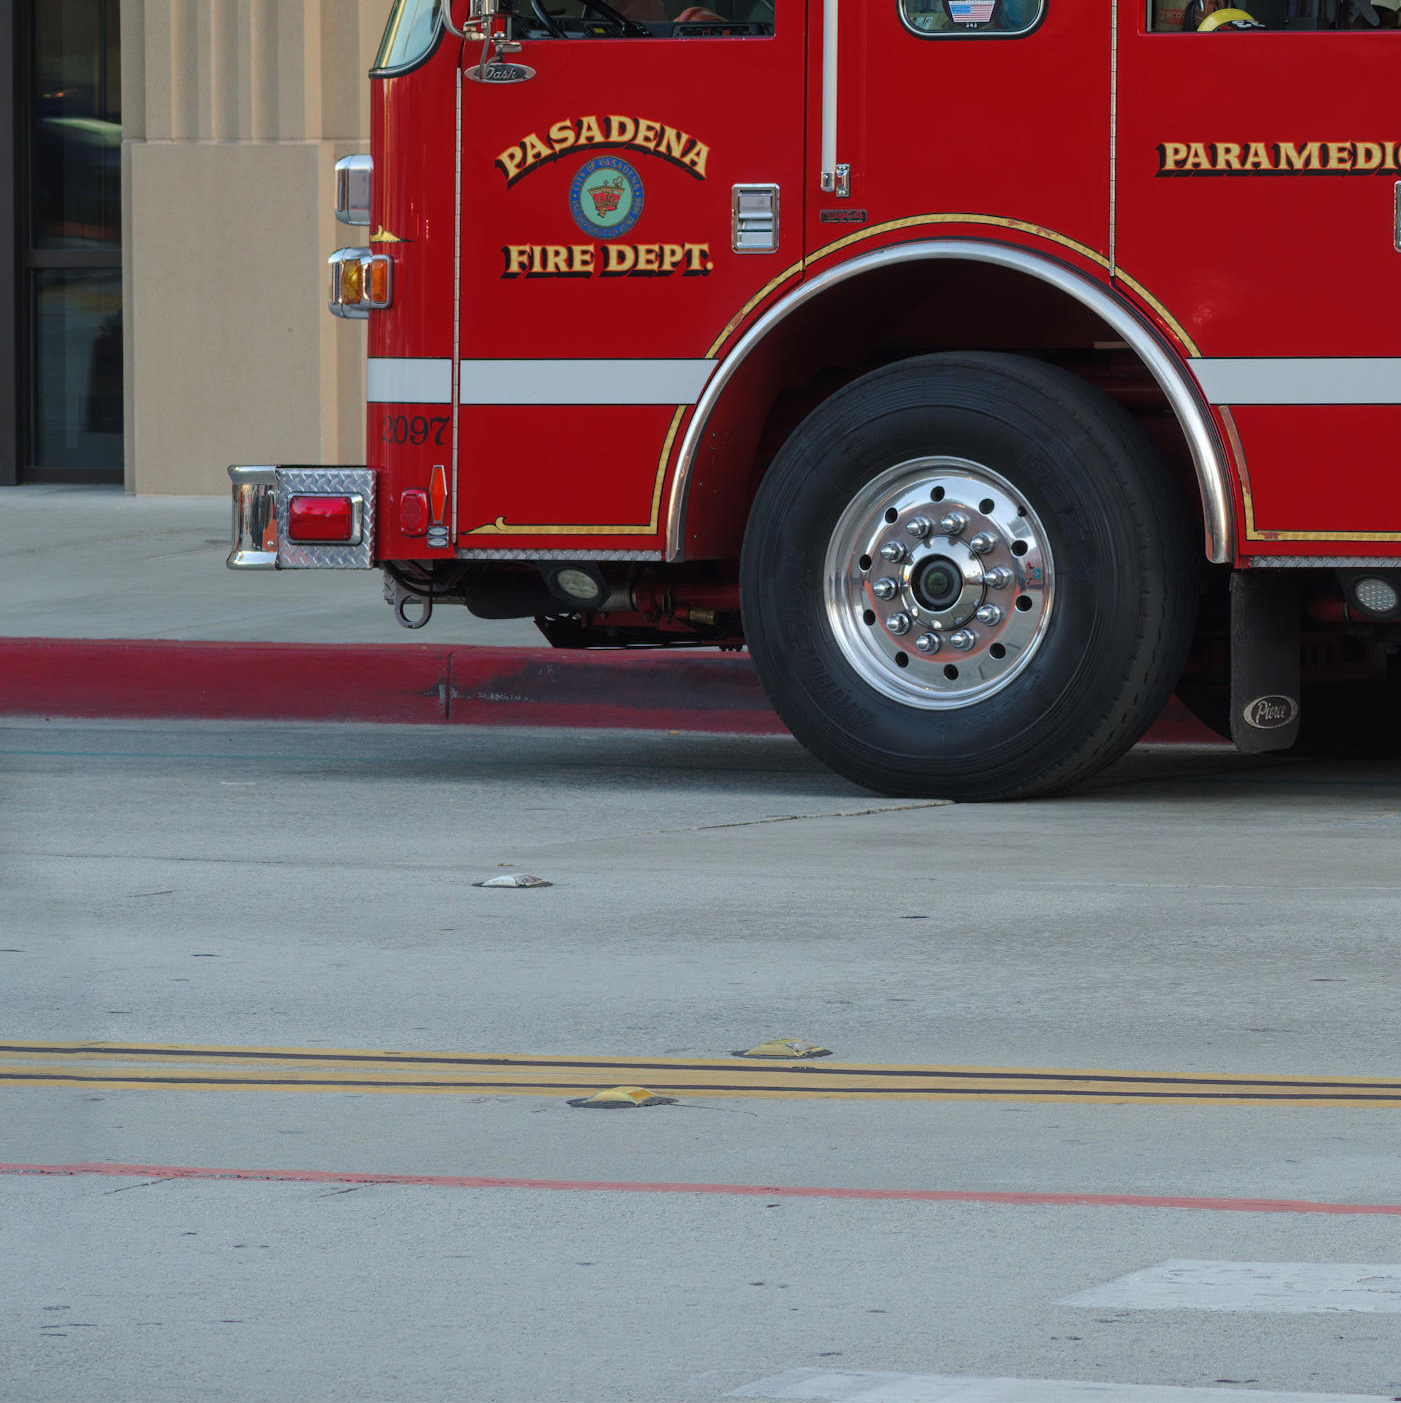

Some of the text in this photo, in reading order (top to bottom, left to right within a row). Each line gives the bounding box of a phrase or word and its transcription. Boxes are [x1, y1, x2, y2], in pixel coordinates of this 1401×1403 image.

[495, 115, 711, 190] PASADENA
[501, 243, 714, 279] FIRE DEPT.
[382, 415, 450, 445] 2097
